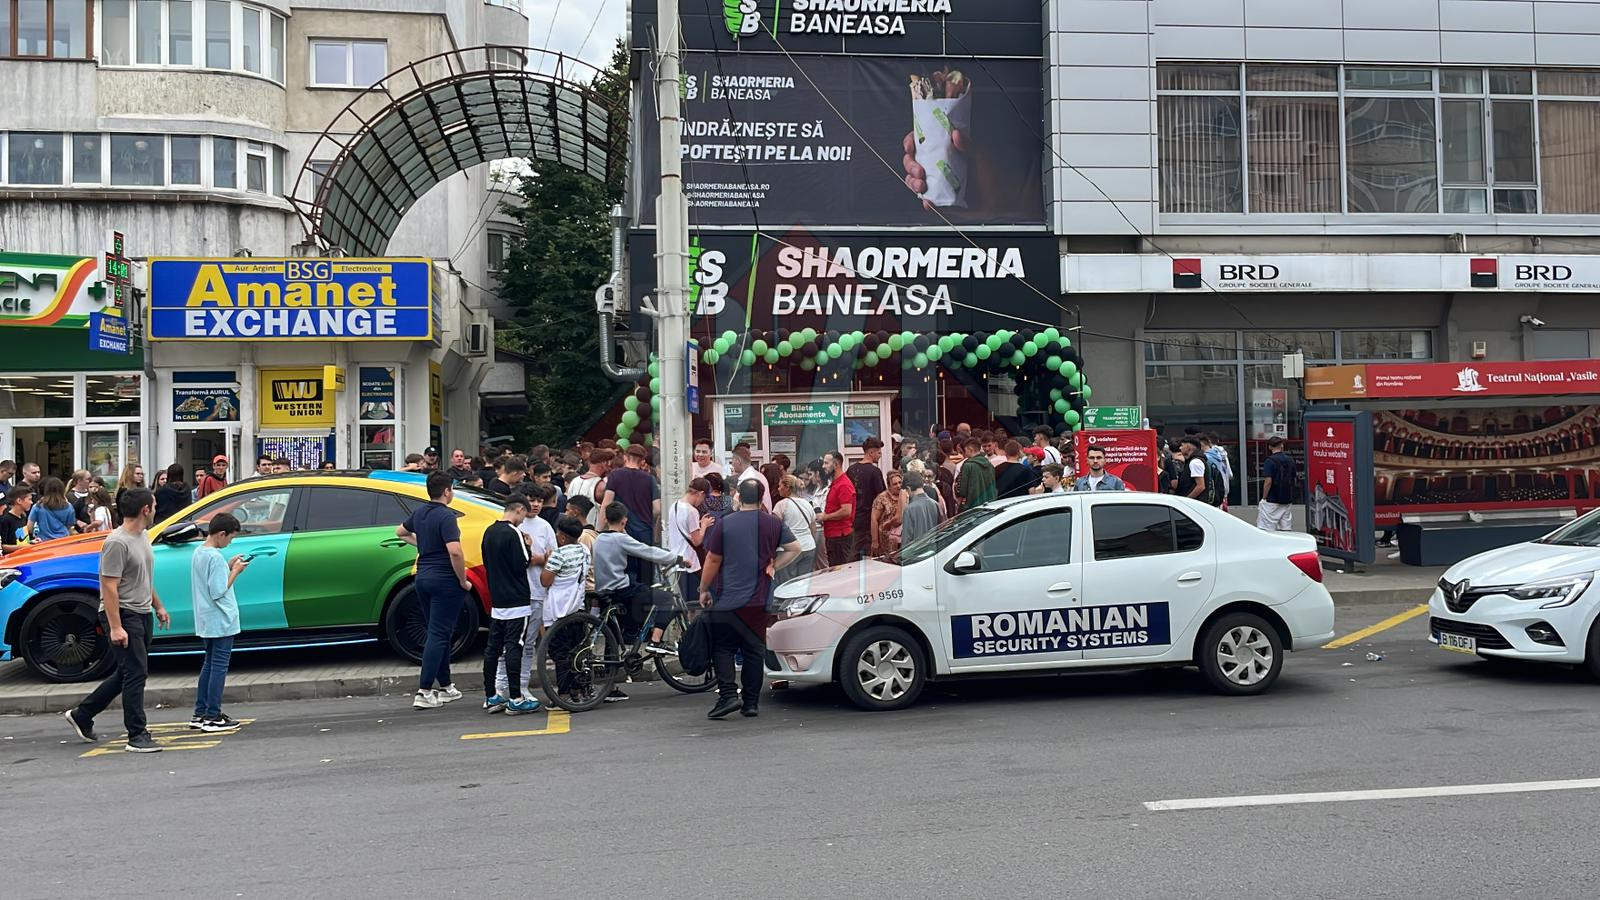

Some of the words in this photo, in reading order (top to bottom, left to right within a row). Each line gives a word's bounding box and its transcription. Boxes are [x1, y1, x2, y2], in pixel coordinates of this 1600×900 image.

[791, 14, 906, 34] BANEASA
[712, 76, 795, 89] SHAORMERIA
[711, 89, 771, 100] BANEASA
[801, 120, 824, 138] SĂ
[764, 146, 787, 160] PE
[790, 146, 813, 160] LA
[817, 146, 851, 161] NOI!
[252, 265, 277, 273] Argint
[288, 262, 328, 279] BSG
[341, 264, 383, 272] Electronice
[776, 247, 1025, 279] SHAORMERIA
[1219, 264, 1280, 280] BRD
[1515, 265, 1572, 280] BRD
[185, 264, 397, 308] Amanet
[772, 284, 954, 315] BANEASA
[100, 317, 126, 336] Amanet
[185, 309, 397, 336] EXCHANGE
[100, 339, 126, 352] EXCHANGE
[1487, 373, 1522, 382] Teatrul
[1524, 372, 1564, 384] Național
[274, 402, 323, 410] WESTERN
[778, 411, 826, 419] Abonamente
[857, 594, 875, 605] 021
[878, 589, 904, 600] 9569
[971, 604, 1149, 639] ROMANIAN
[972, 636, 1061, 655] SECURITY
[1067, 630, 1149, 648] SYSTEMS
